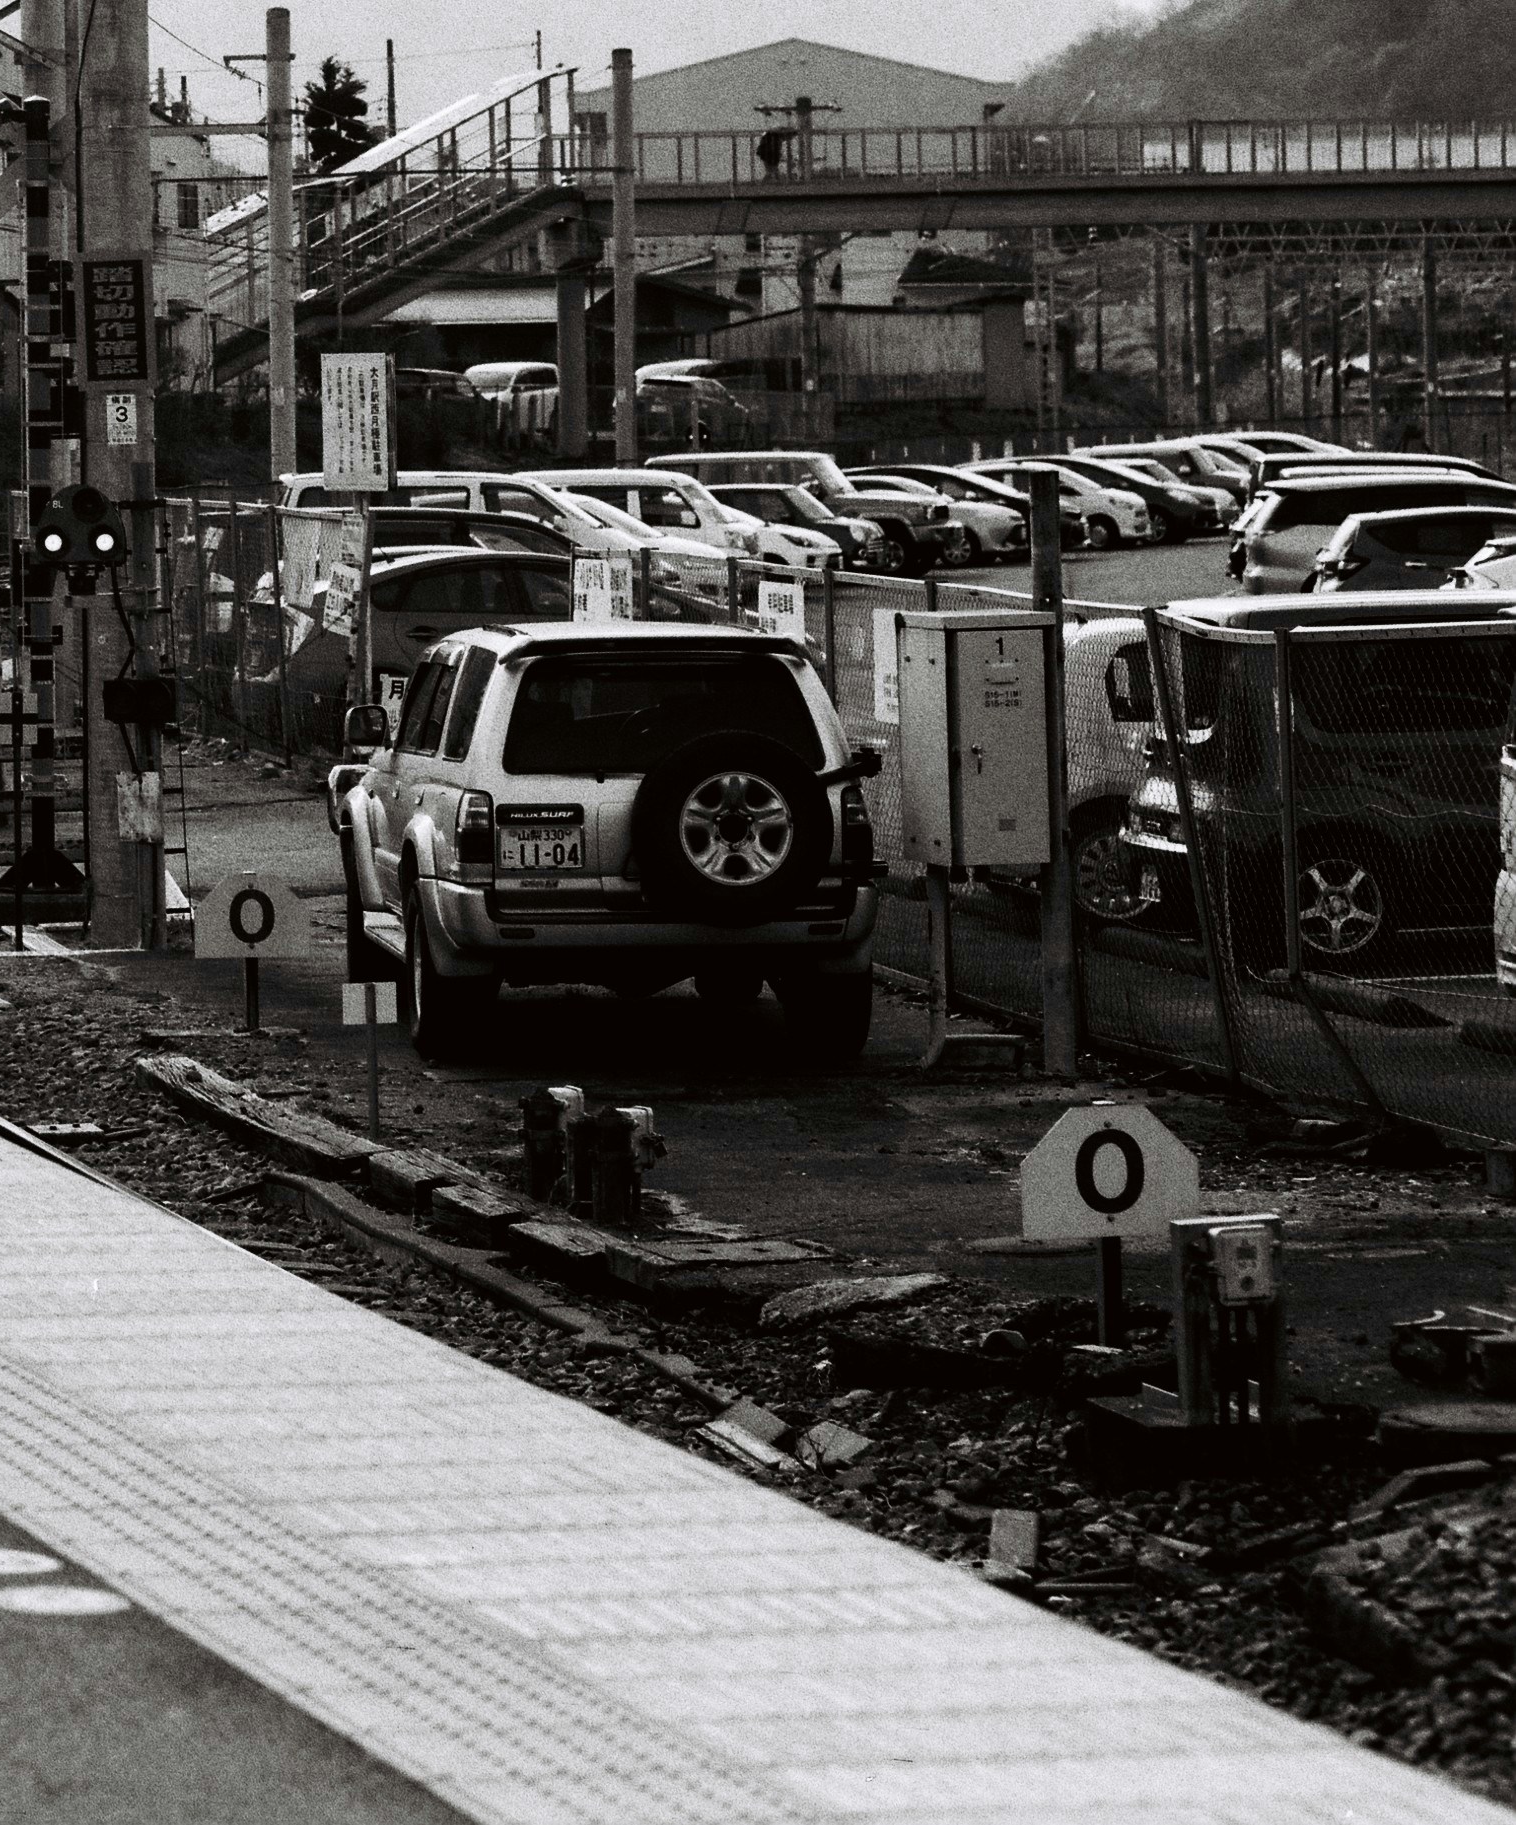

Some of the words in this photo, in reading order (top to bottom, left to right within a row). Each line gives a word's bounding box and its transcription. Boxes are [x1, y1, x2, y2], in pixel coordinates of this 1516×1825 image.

[92, 265, 139, 375] 踏切動作確認
[115, 406, 128, 422] 3
[995, 637, 1003, 655] 1
[229, 889, 275, 944] 0
[1075, 1128, 1145, 1214] 0
